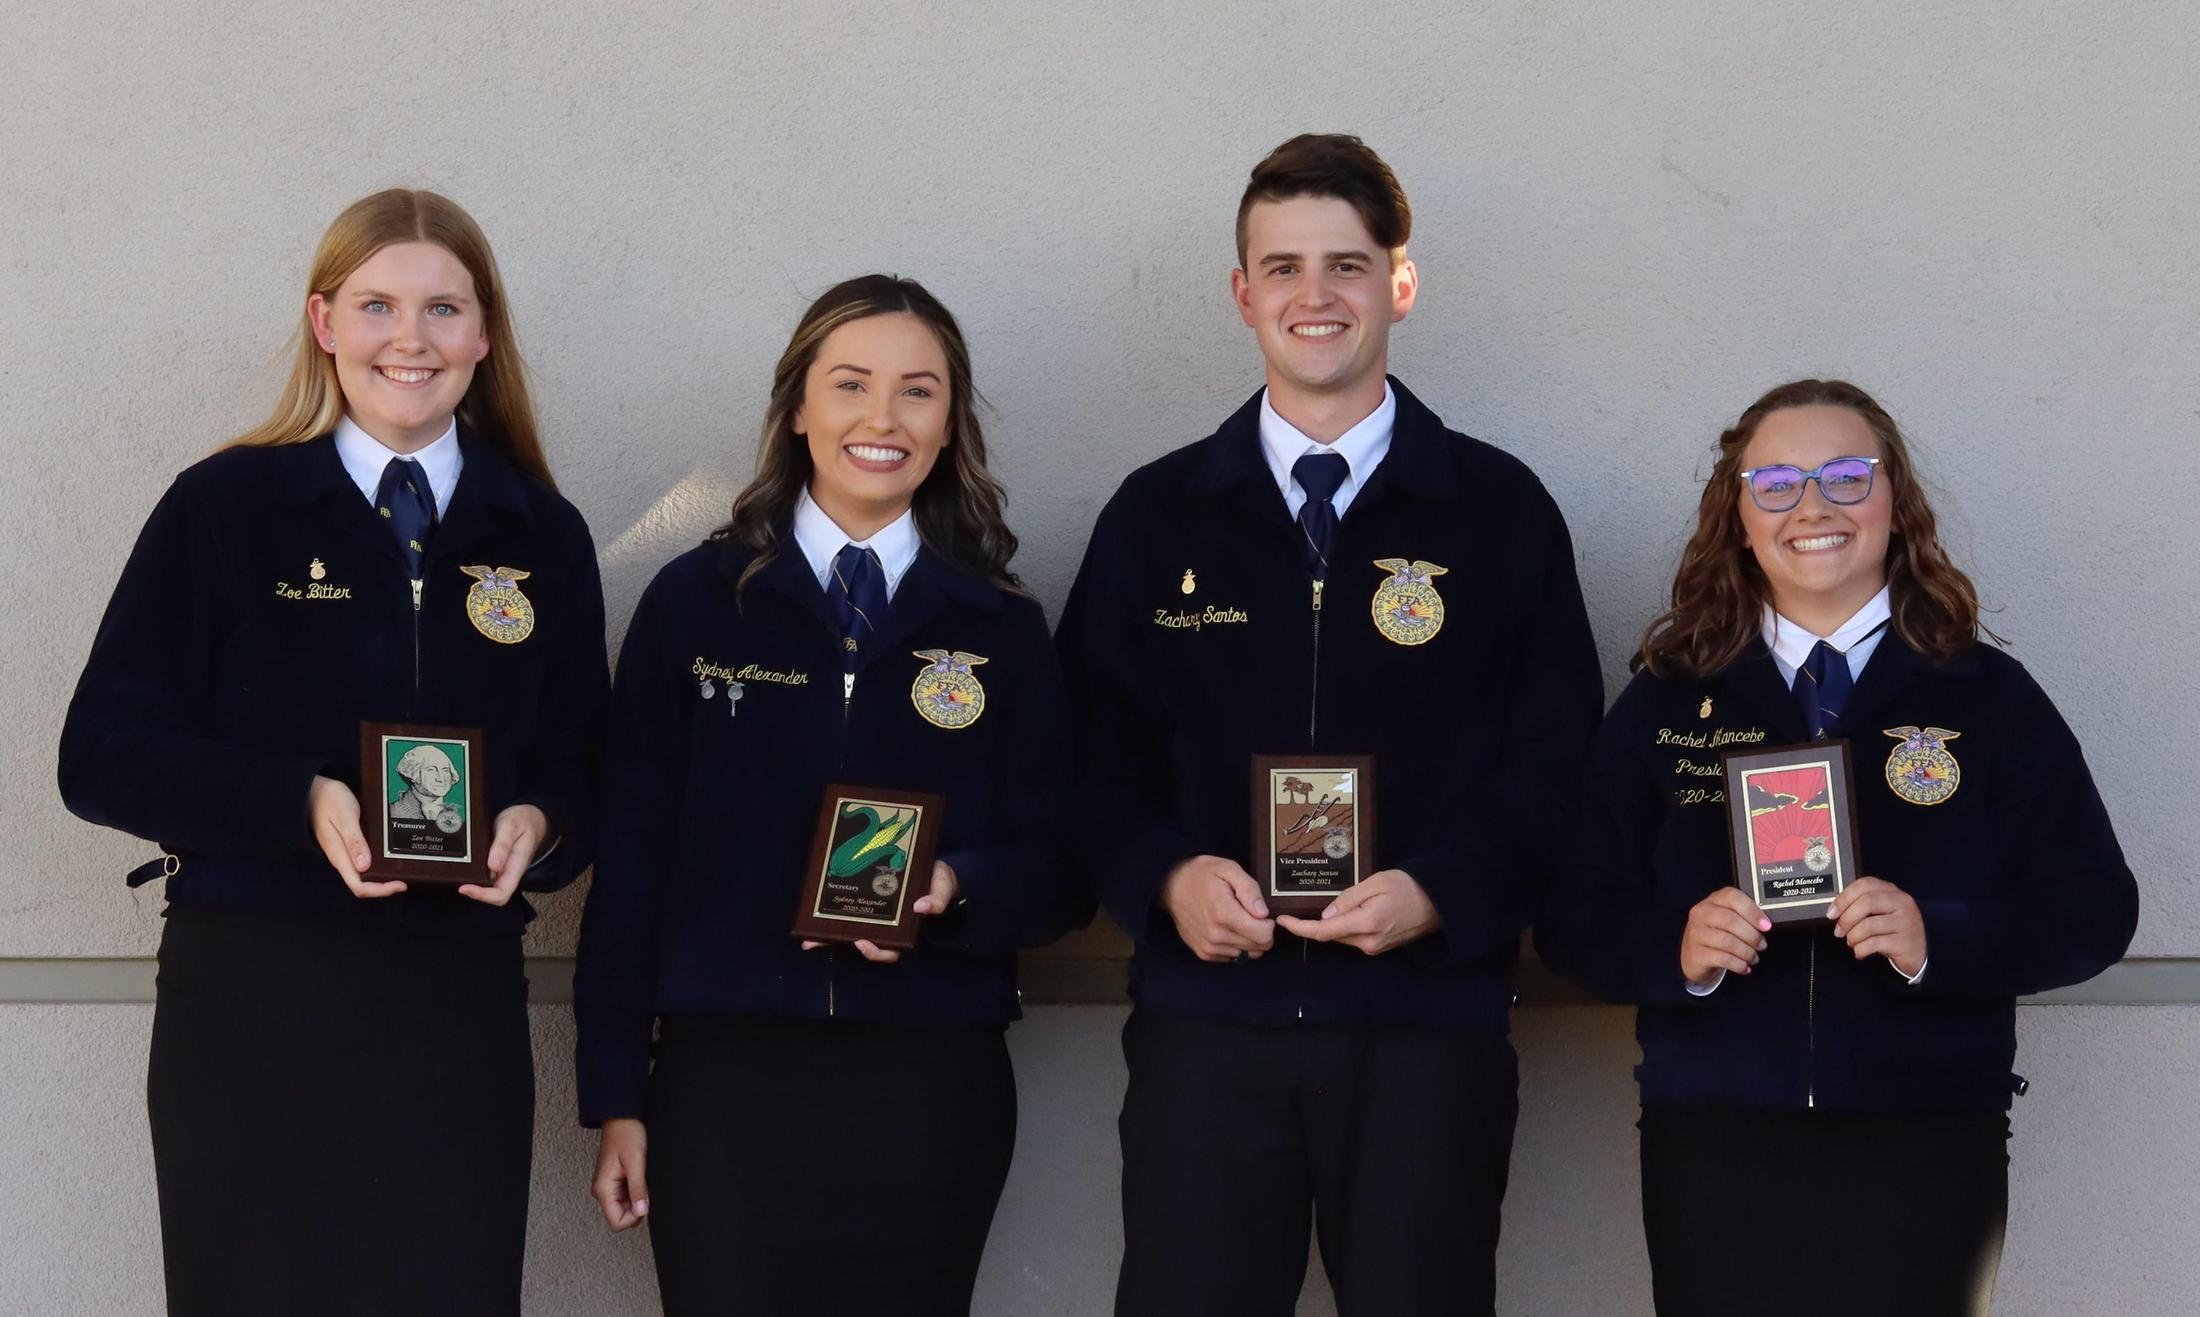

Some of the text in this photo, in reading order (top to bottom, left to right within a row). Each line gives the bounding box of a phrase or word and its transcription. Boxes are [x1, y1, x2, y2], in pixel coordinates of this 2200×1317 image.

[276, 582, 352, 600] Zoe Bitter
[1202, 605, 1248, 623] Santos
[692, 656, 808, 685] Sydney Alexander
[1656, 726, 1765, 748] Rachel Mancebo
[391, 821, 427, 831] Treasurer
[1760, 865, 1794, 876] President
[827, 881, 859, 892] Secretary
[1772, 876, 1824, 889] Rachel Mancebo
[1782, 887, 1817, 897] 2020-2021
